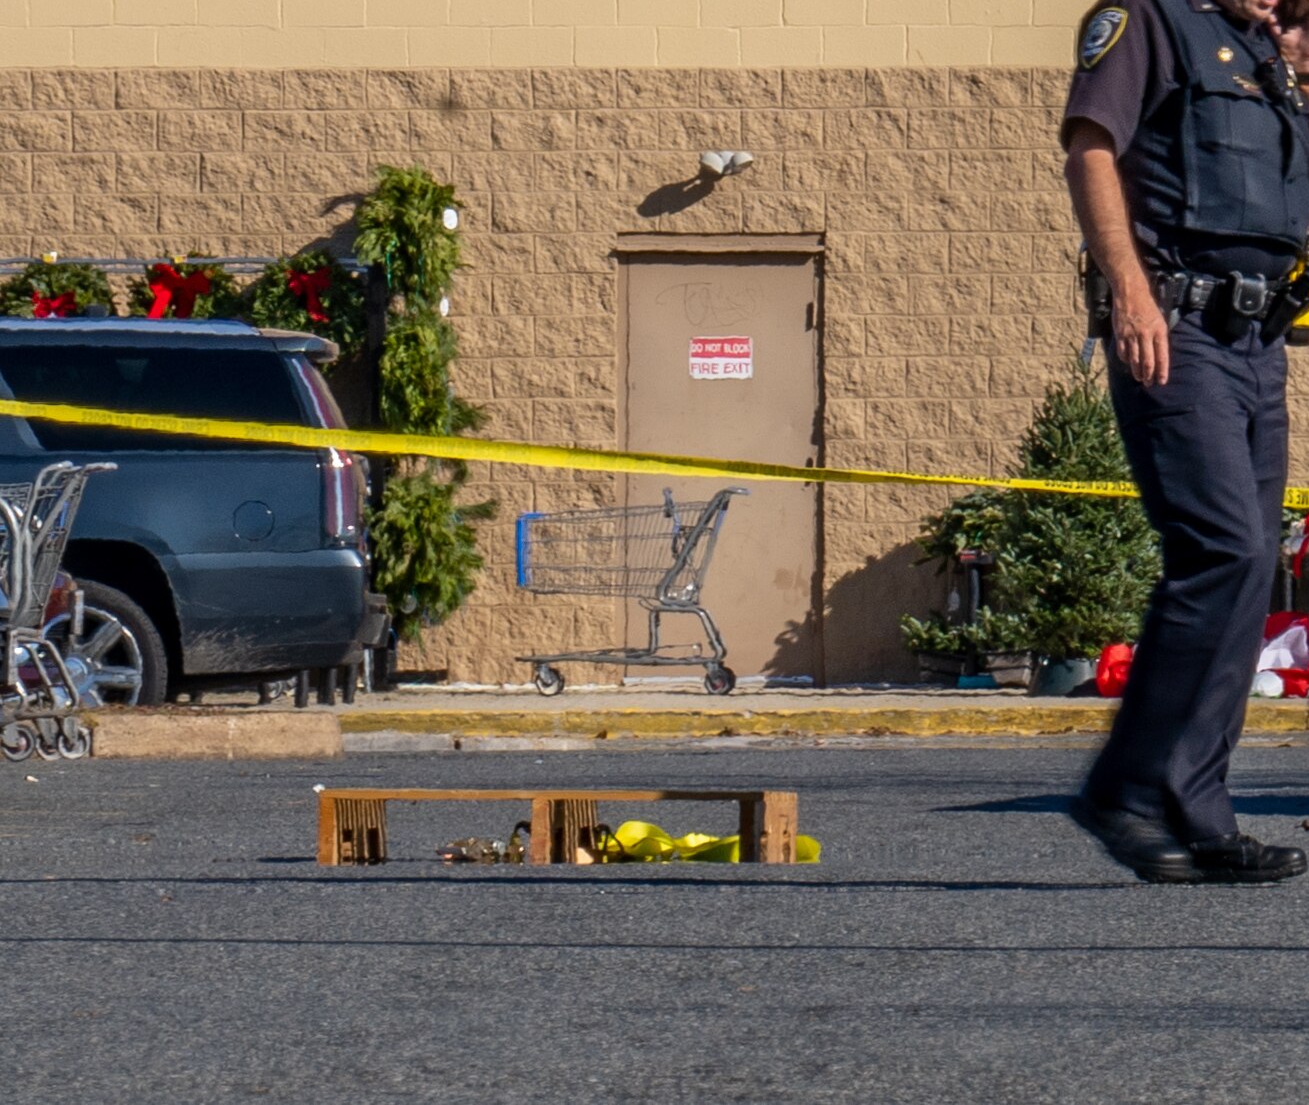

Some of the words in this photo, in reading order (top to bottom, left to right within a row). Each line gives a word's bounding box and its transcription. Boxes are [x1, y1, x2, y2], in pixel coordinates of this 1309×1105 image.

[691, 343, 703, 353] DO
[705, 343, 721, 353] NOT
[723, 343, 750, 354] BLOCK
[691, 363, 719, 374] FIRE
[724, 362, 750, 374] EXIT
